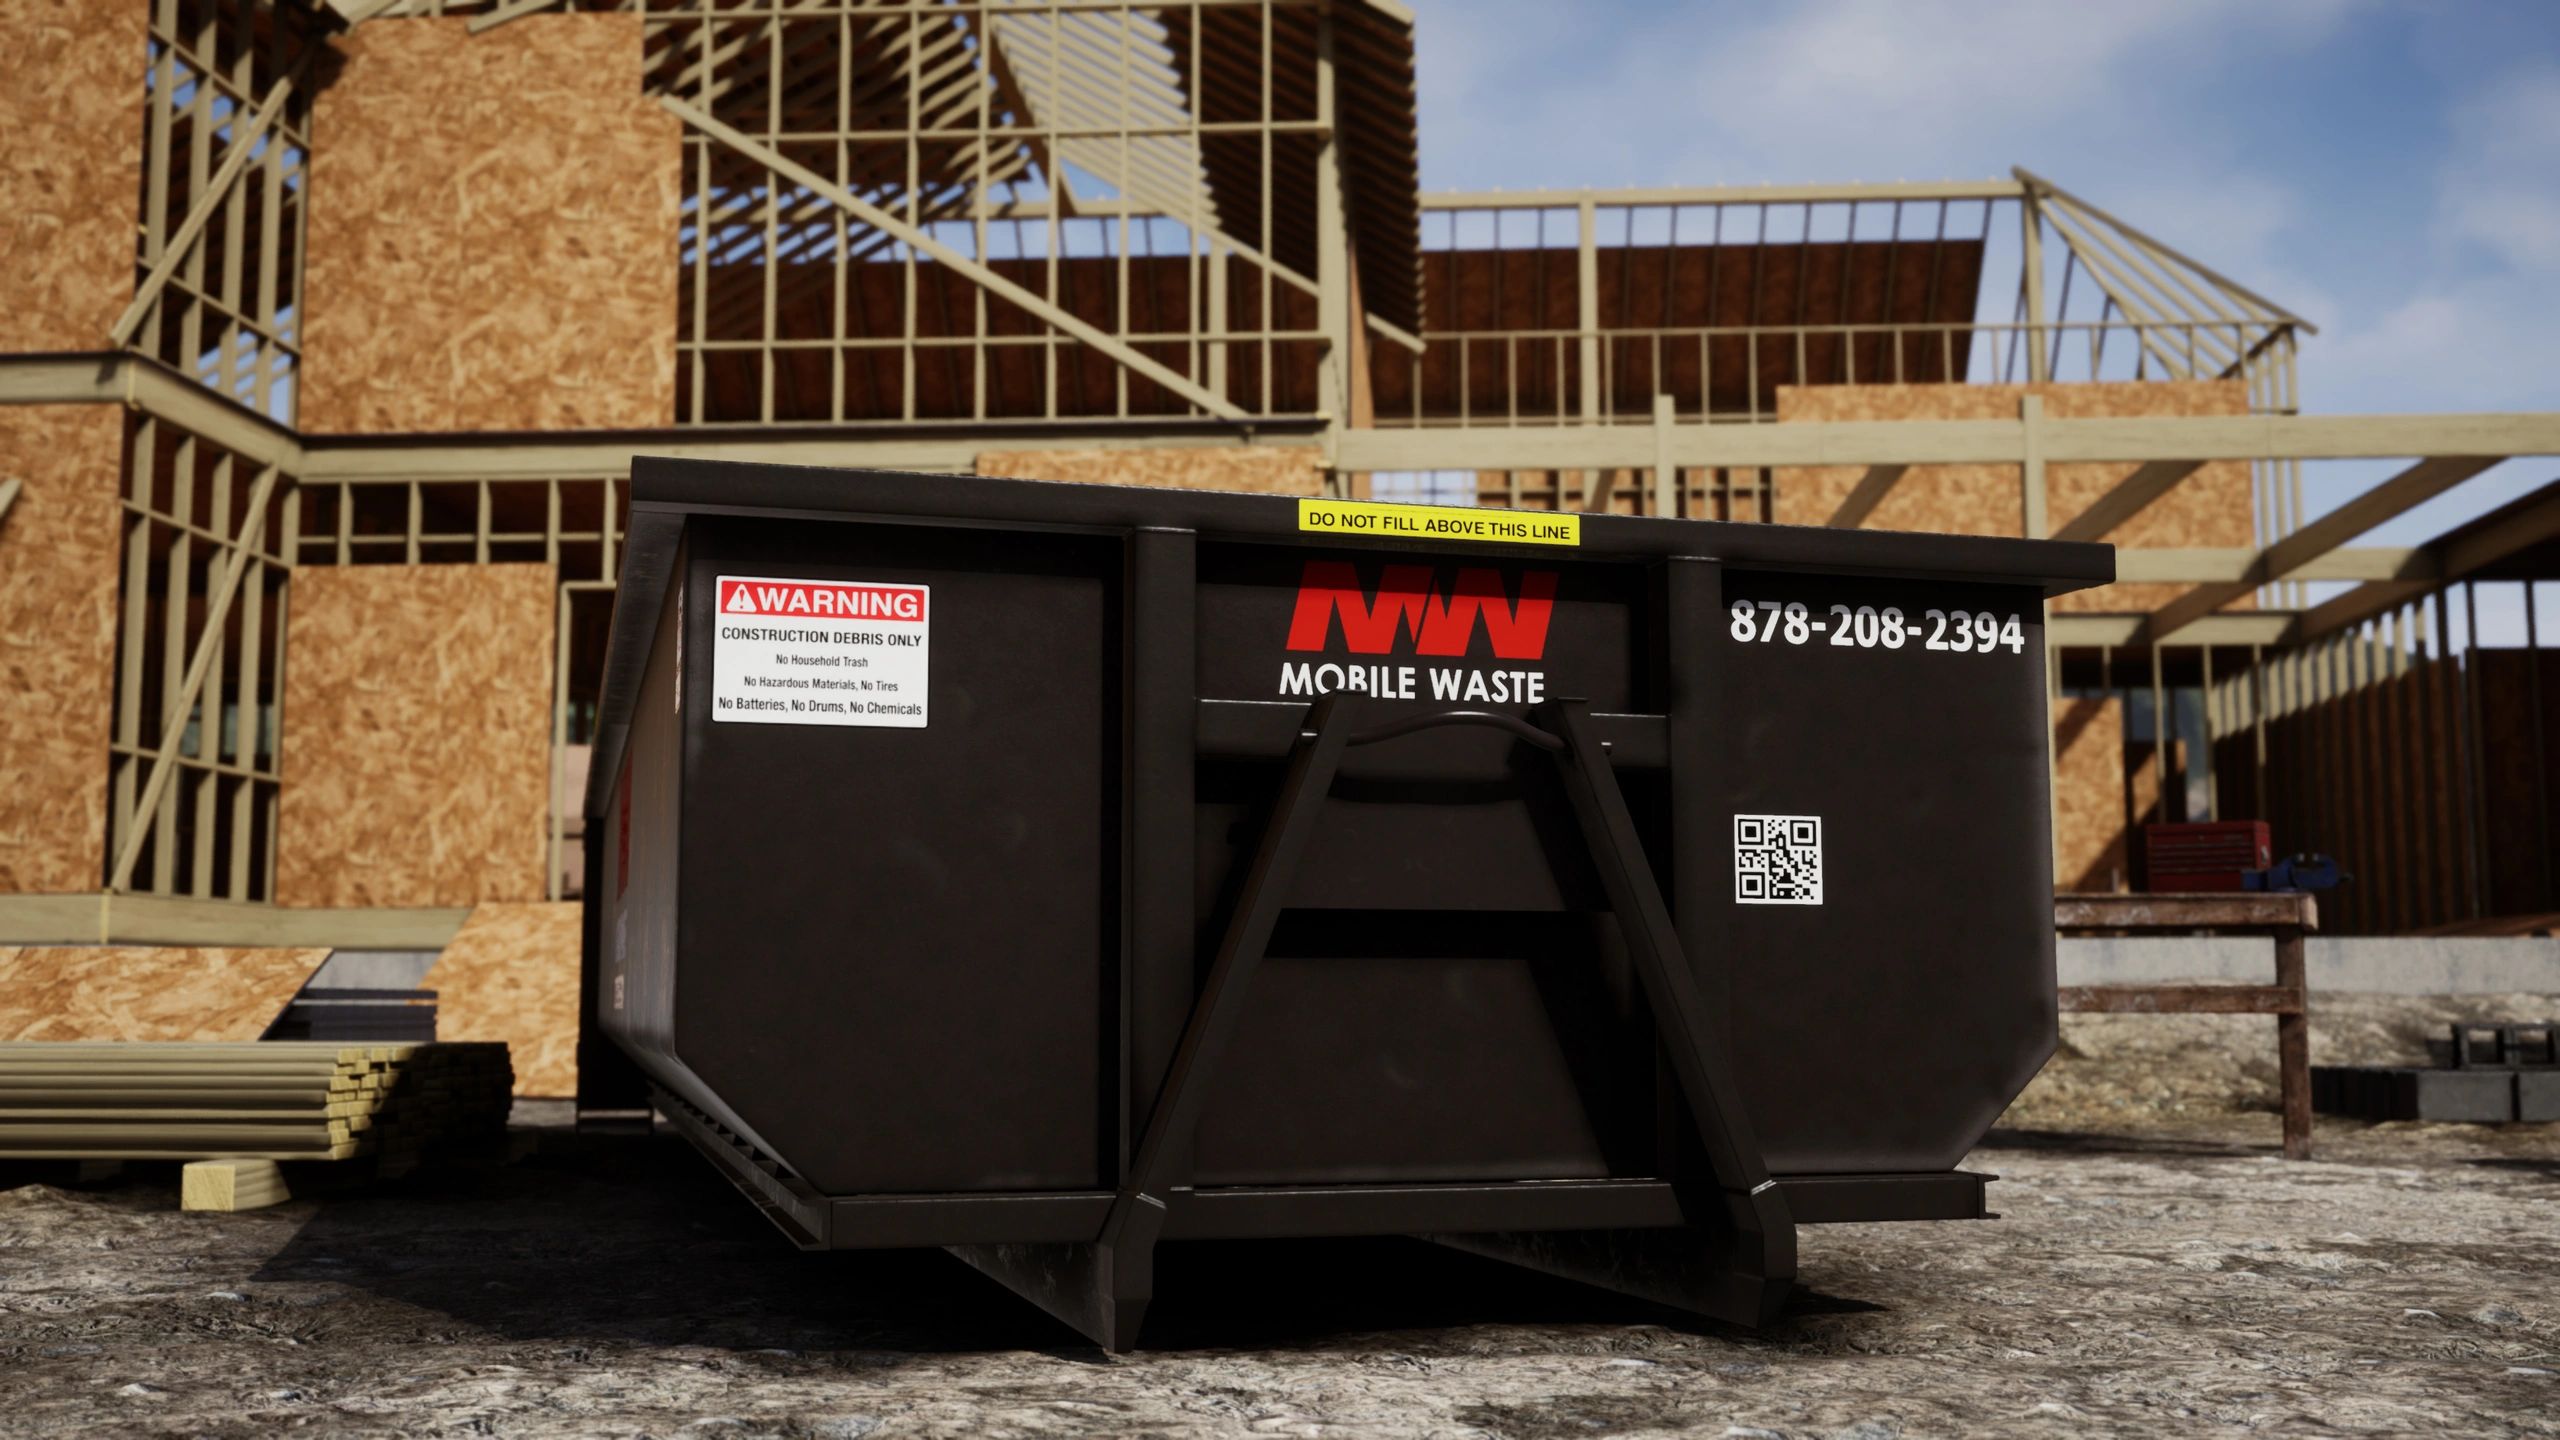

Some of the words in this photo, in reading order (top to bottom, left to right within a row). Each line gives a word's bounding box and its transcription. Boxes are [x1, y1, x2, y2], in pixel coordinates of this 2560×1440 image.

[1309, 512, 1335, 526] DO
[1342, 514, 1377, 529] NOT
[1384, 517, 1419, 531] FILL
[1425, 519, 1484, 535] ABOVE
[1489, 522, 1527, 537] THIS
[1533, 525, 1570, 539] LINE
[756, 587, 918, 618] WARNING
[722, 627, 829, 643] CONSTRUCTION
[833, 632, 883, 646] DEBRIS
[888, 634, 922, 647] ONLY
[1730, 599, 2025, 654] 878-208-2394
[776, 654, 788, 665] No
[791, 655, 840, 667] Household
[844, 657, 868, 668] Trash
[744, 676, 756, 687] No
[759, 677, 809, 688] Hazardous
[812, 678, 858, 692] Materials,
[861, 680, 873, 691] No
[876, 680, 898, 692] Tires
[1279, 662, 1415, 699] MOBILE
[1429, 668, 1544, 704] WASTE
[719, 697, 732, 709] No
[737, 698, 788, 712] Batteries,
[791, 700, 805, 712] No
[809, 700, 847, 714] Drums,
[850, 702, 863, 714] No
[867, 702, 922, 716] Chemicals
